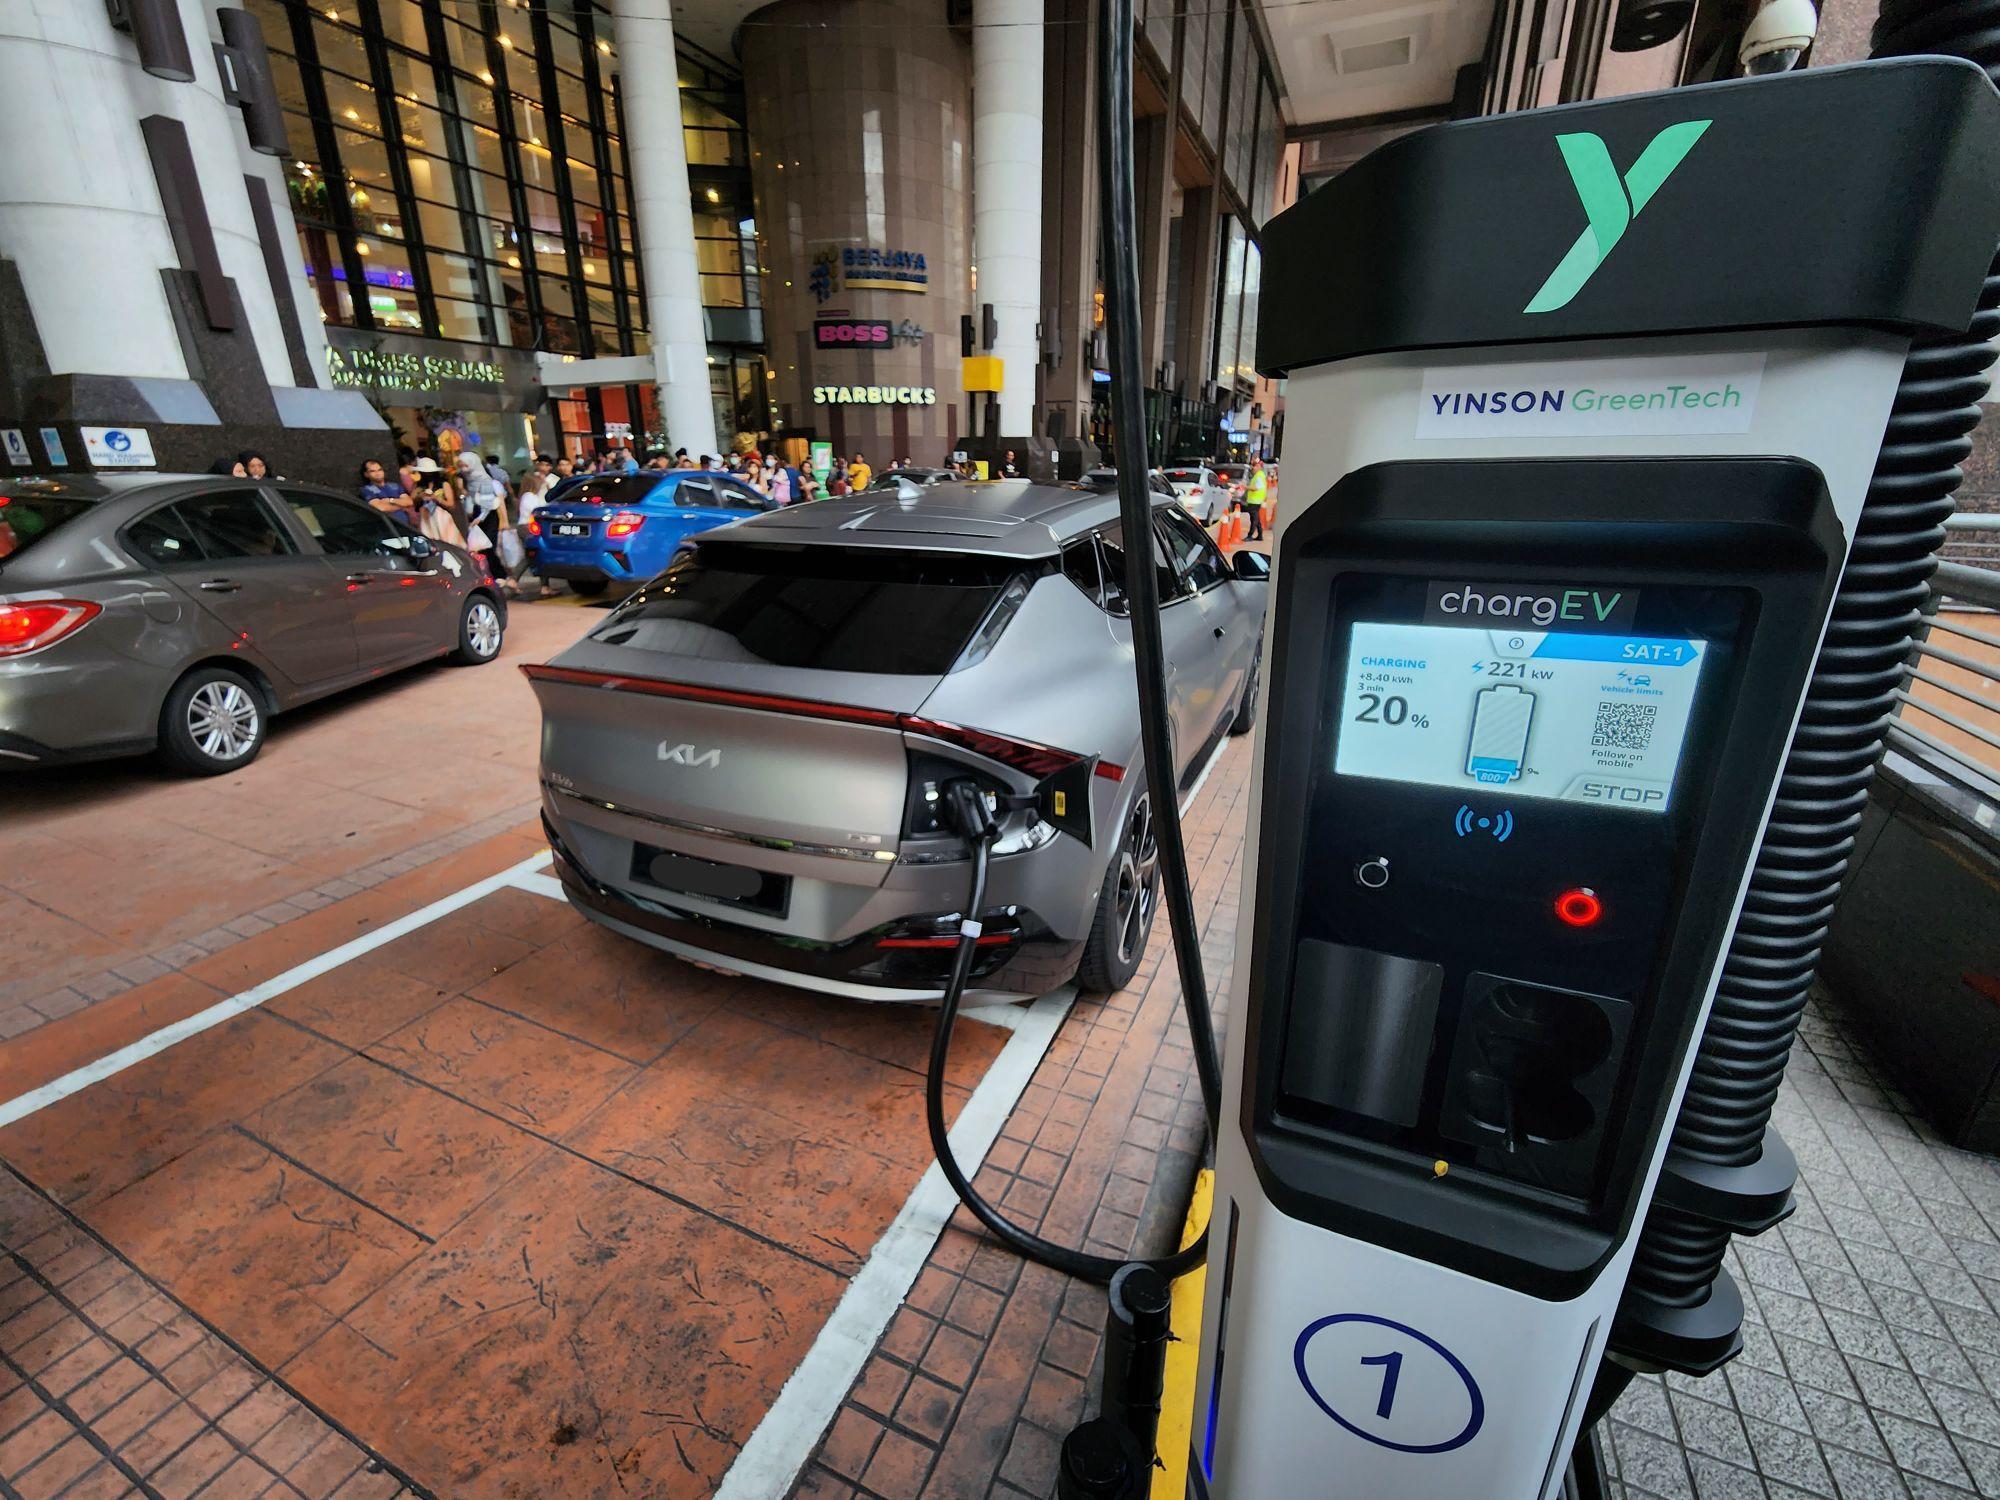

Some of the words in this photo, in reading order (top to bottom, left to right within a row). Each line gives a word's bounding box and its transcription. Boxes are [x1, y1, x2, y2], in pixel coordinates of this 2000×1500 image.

[843, 247, 927, 270] BERJAYA
[818, 324, 889, 342] BOSS
[813, 386, 936, 405] STARBUCKS
[1432, 389, 1565, 415] YINSON
[1571, 384, 1741, 412] GreenTech
[1439, 585, 1622, 626] chargEV
[1622, 643, 1685, 661] SAT-1
[1361, 656, 1427, 669] CHARGING
[1488, 661, 1526, 678] 221
[1531, 670, 1554, 680] kW
[1357, 682, 1364, 691] 3
[1366, 684, 1384, 692] min
[1360, 672, 1390, 682] +8.40
[1392, 675, 1413, 684] kWh
[1601, 684, 1634, 694] Vehicle
[1636, 687, 1664, 696] limits
[1591, 749, 1627, 761] Follow
[1629, 753, 1643, 761] on
[1597, 759, 1634, 769] mobile
[1583, 783, 1664, 803] STOP
[1360, 1351, 1403, 1420] 1
